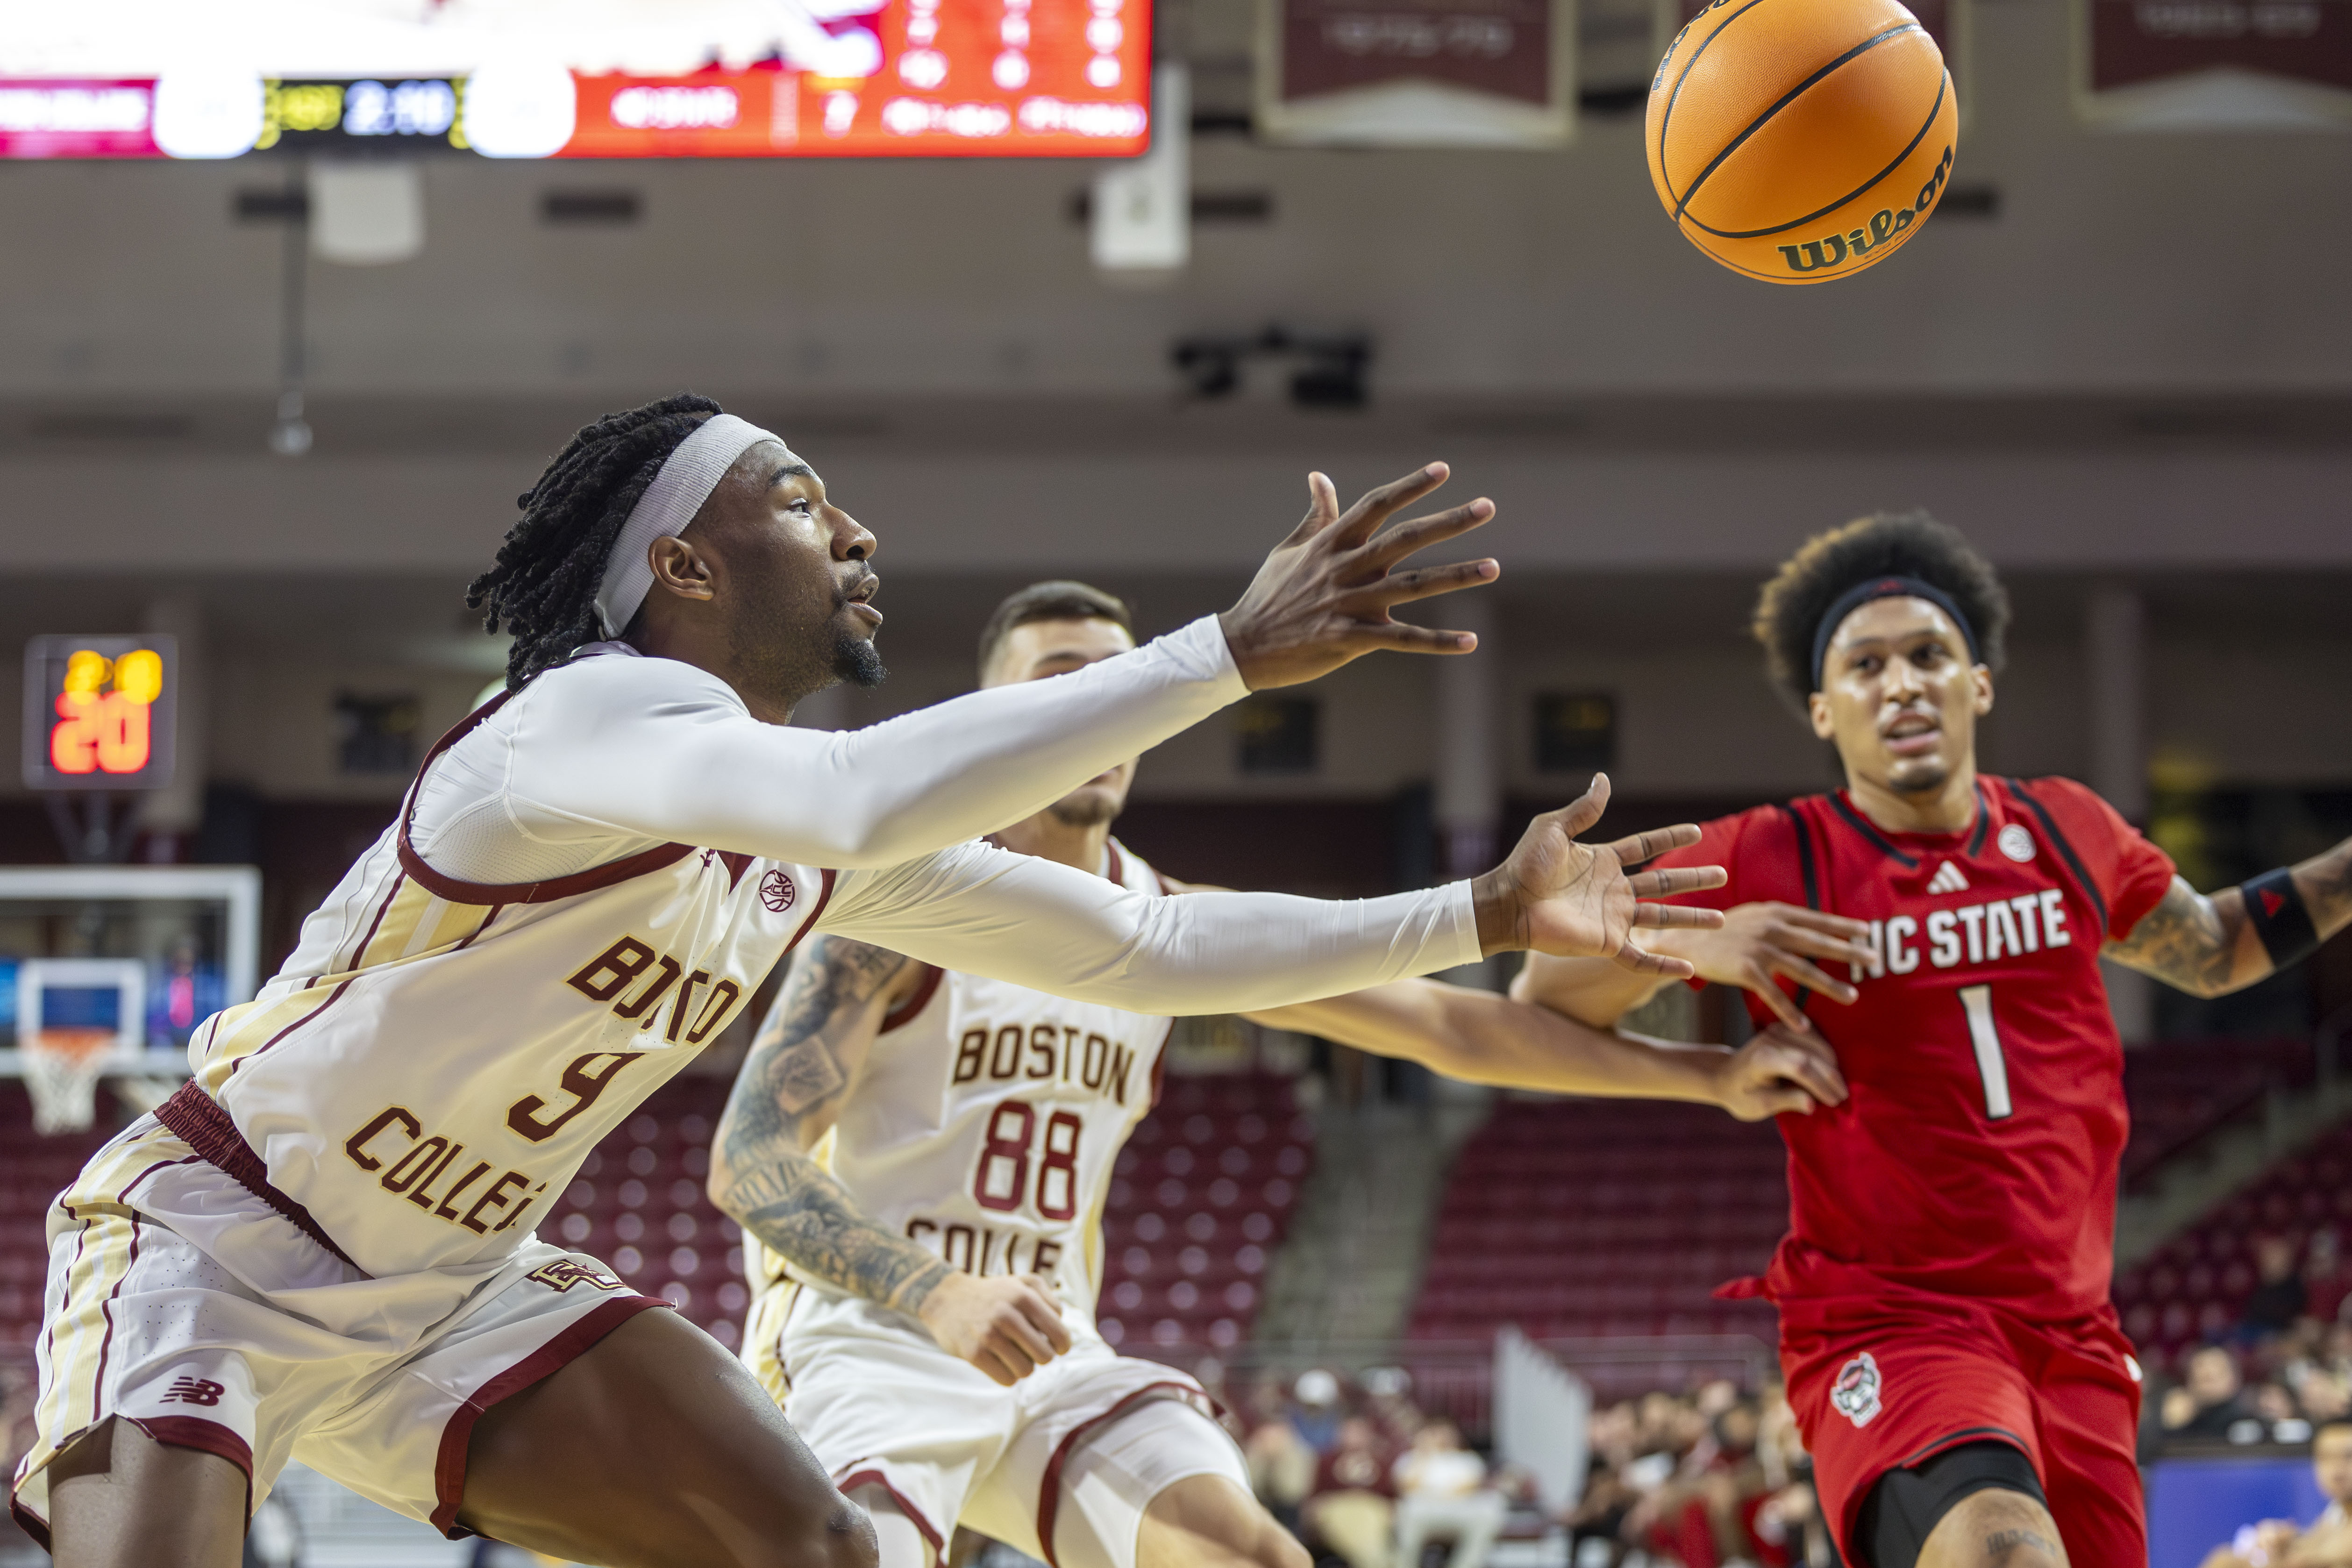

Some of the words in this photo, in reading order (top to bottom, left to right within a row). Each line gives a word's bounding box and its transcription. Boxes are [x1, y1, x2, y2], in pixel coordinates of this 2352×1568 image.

[1777, 144, 1953, 272] Wilson
[763, 882, 793, 895] ACC
[1925, 887, 2072, 969] STATE
[505, 1052, 649, 1144] 9
[952, 1026, 1134, 1107] BOSTON
[1958, 984, 2013, 1120] 1
[342, 1104, 548, 1237] COLLE
[974, 1099, 1083, 1222] 88
